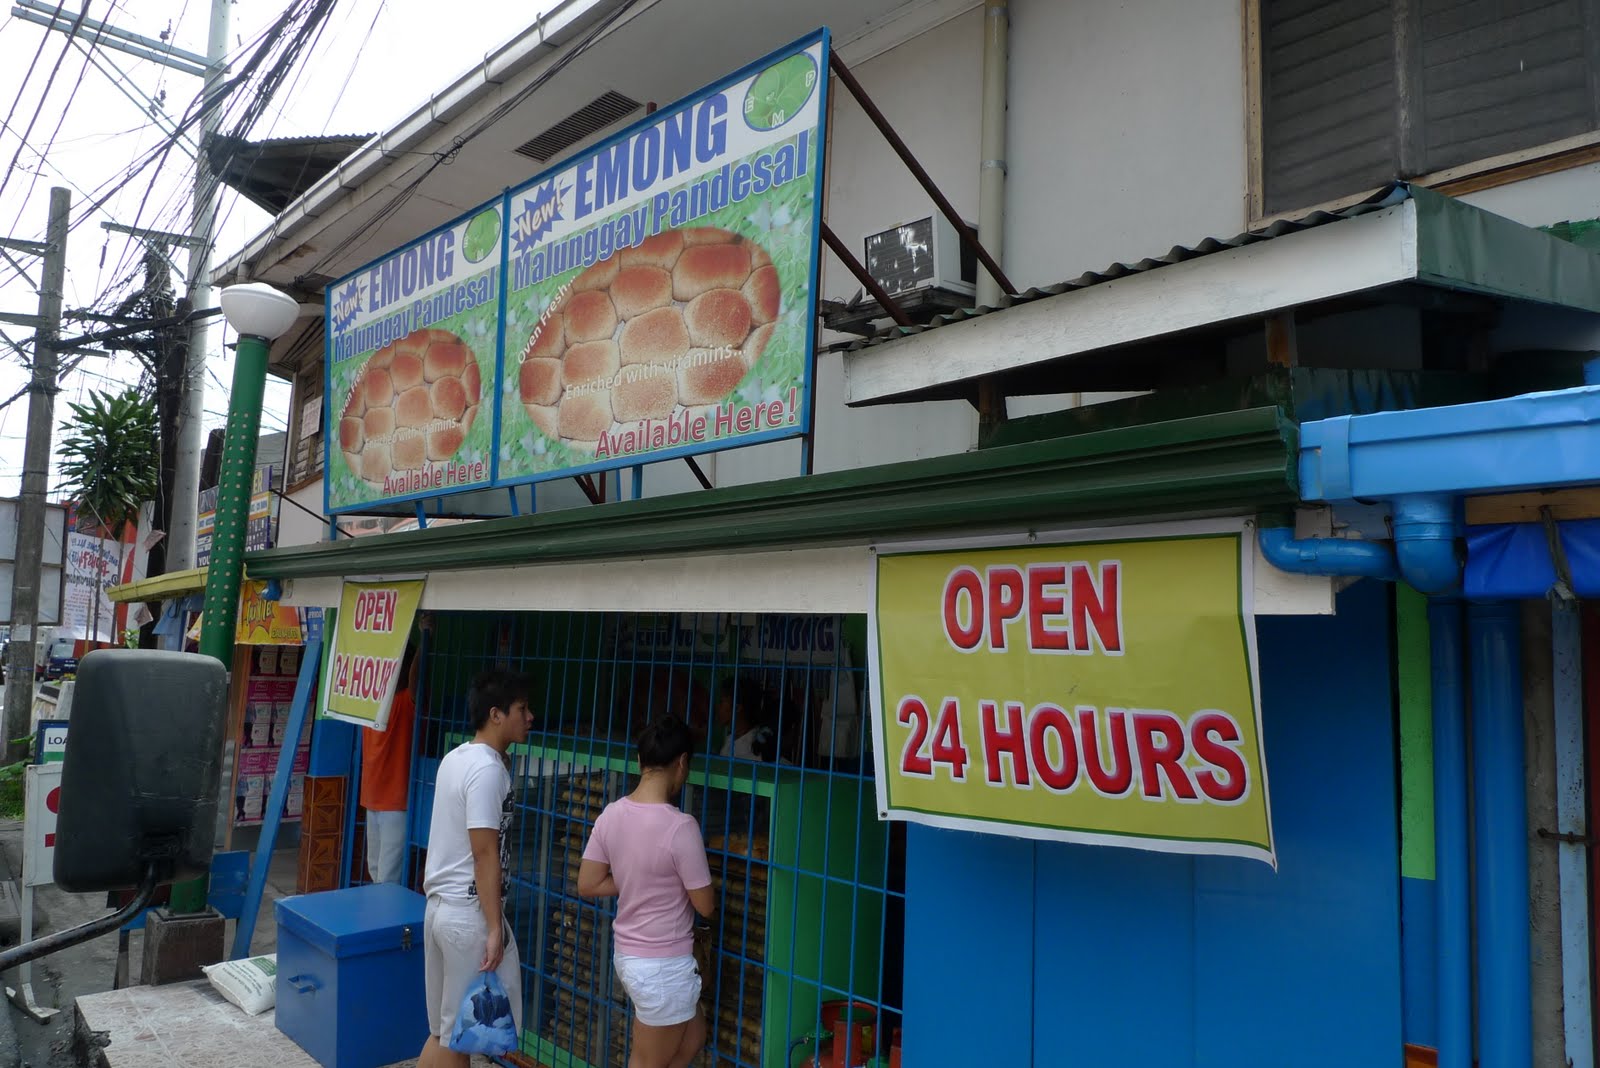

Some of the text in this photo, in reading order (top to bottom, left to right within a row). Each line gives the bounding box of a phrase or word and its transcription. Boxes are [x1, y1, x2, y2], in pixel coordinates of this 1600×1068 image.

[517, 182, 565, 242] New!
[574, 93, 729, 221] EMONG
[512, 204, 648, 292] Malunggay
[652, 128, 811, 236] Pandesal
[368, 229, 455, 314] EMONG
[335, 266, 497, 364] Malunggay Pandesal
[517, 326, 542, 365] Oven
[338, 392, 353, 421] Oven
[565, 372, 622, 399] Enriched
[626, 362, 662, 383] with
[594, 386, 797, 461] Available Here!
[383, 452, 489, 496] Available Here!
[354, 589, 399, 634] OPEN
[940, 559, 1124, 655] OPEN
[334, 653, 350, 696] 24
[897, 694, 1251, 805] 24 HOURS
